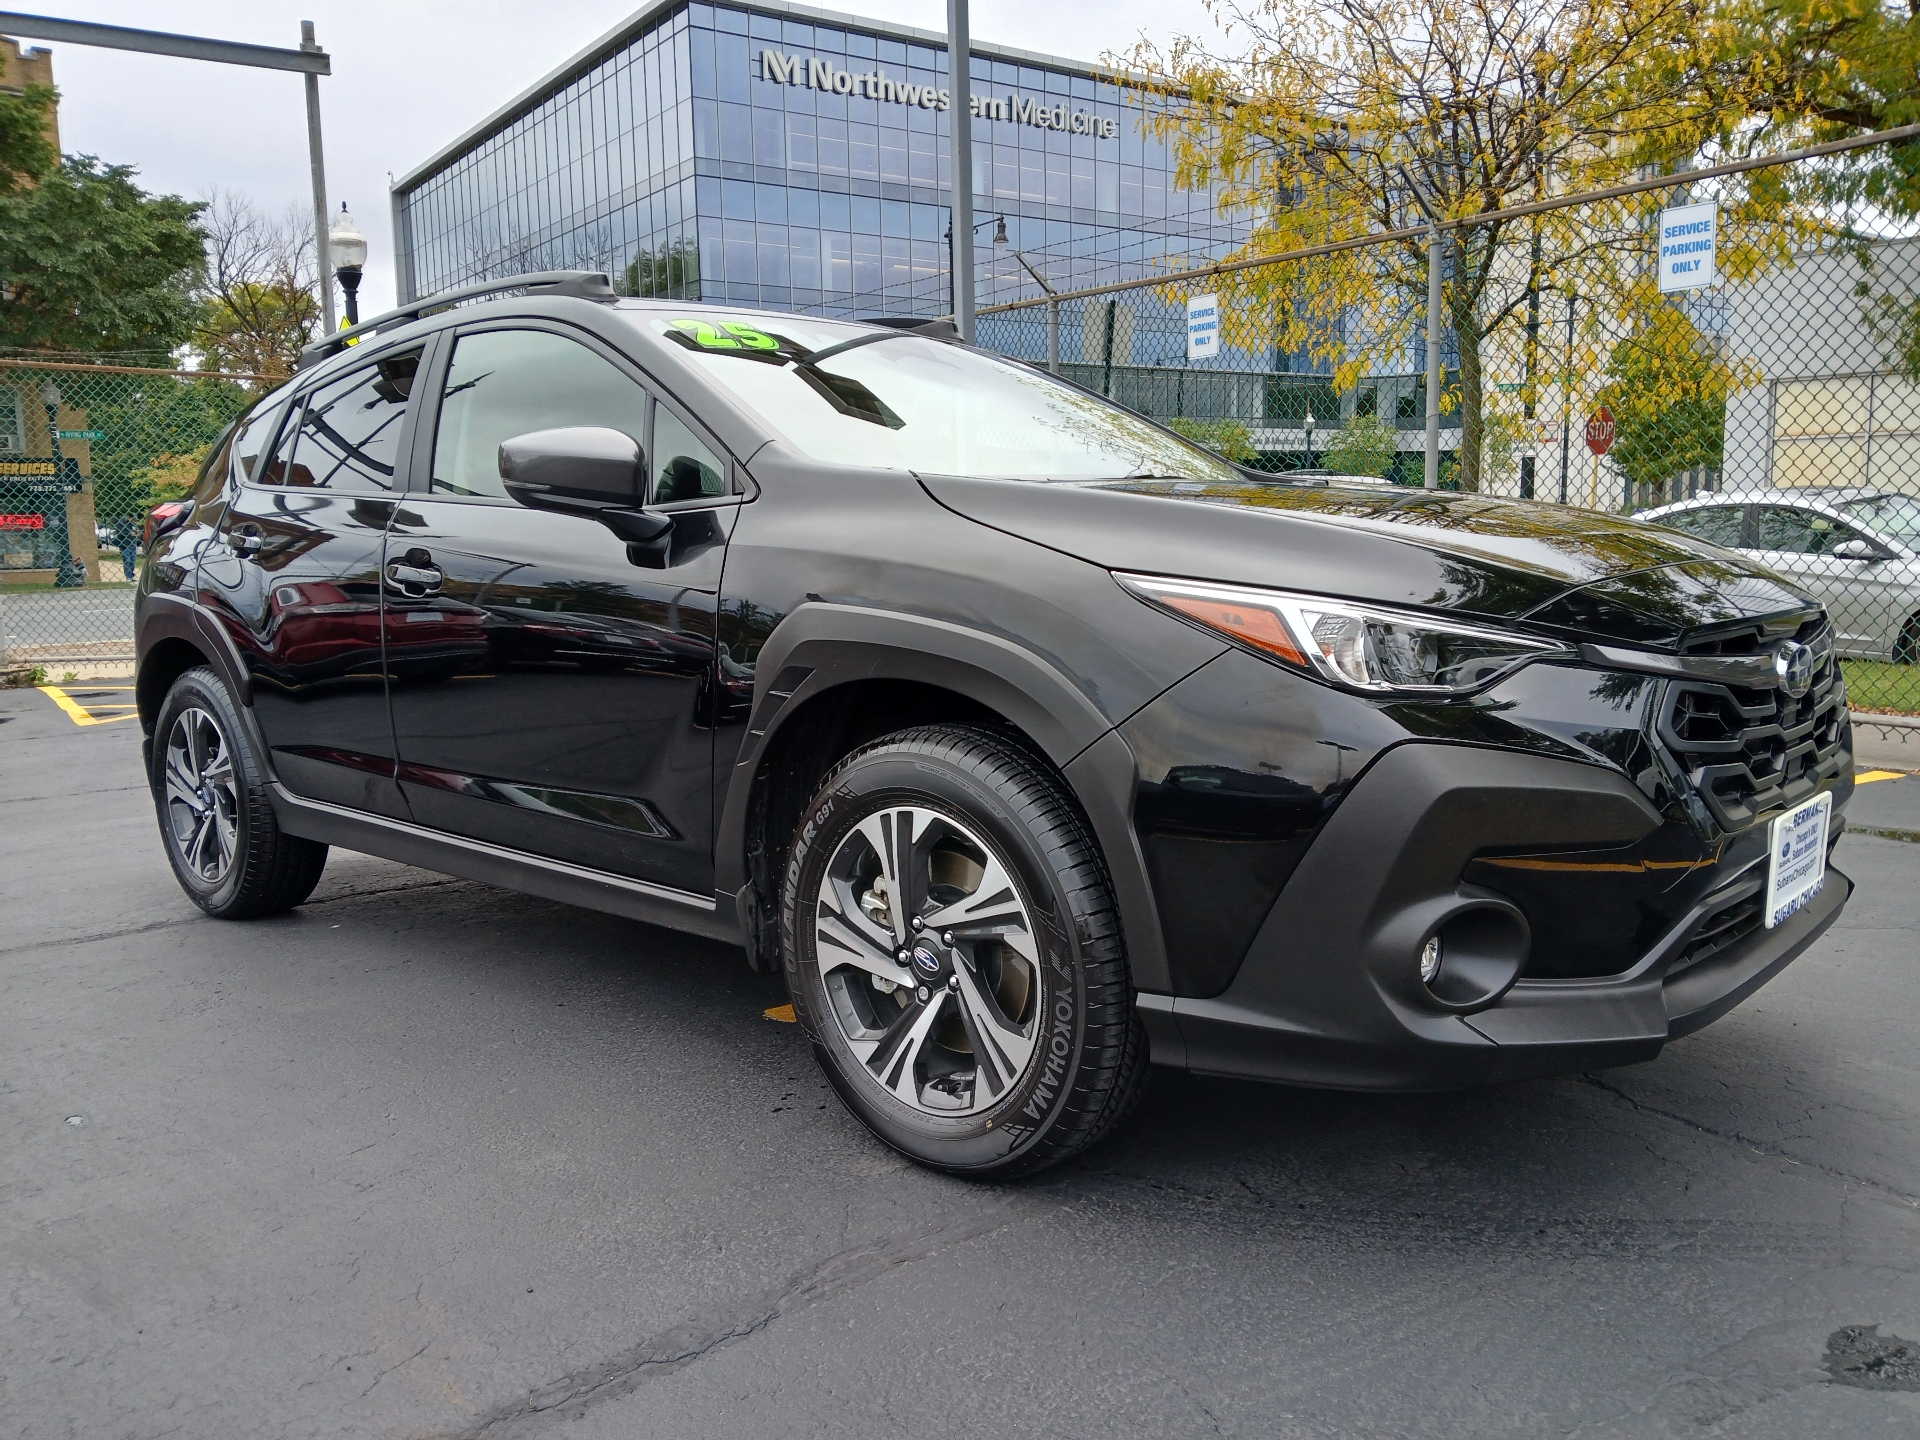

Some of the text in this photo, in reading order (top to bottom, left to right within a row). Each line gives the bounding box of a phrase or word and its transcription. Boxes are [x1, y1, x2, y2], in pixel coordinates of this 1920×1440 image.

[808, 57, 1009, 121] Northwesern
[1011, 93, 1116, 138] Medicine
[1664, 220, 1711, 239] SERVICE
[1662, 239, 1712, 258] PARKING
[1671, 259, 1701, 275] ONLY
[1190, 307, 1215, 320] SERVICE
[670, 319, 781, 350] 25
[1189, 321, 1216, 333] PARKING
[1194, 336, 1211, 346] ONLY
[1587, 421, 1614, 440] STOP
[816, 798, 834, 825] G91
[1776, 856, 1817, 891] SubaruChicago.com
[1773, 894, 1800, 926] SUBARU
[1022, 986, 1073, 1121] YOKOHAMA
